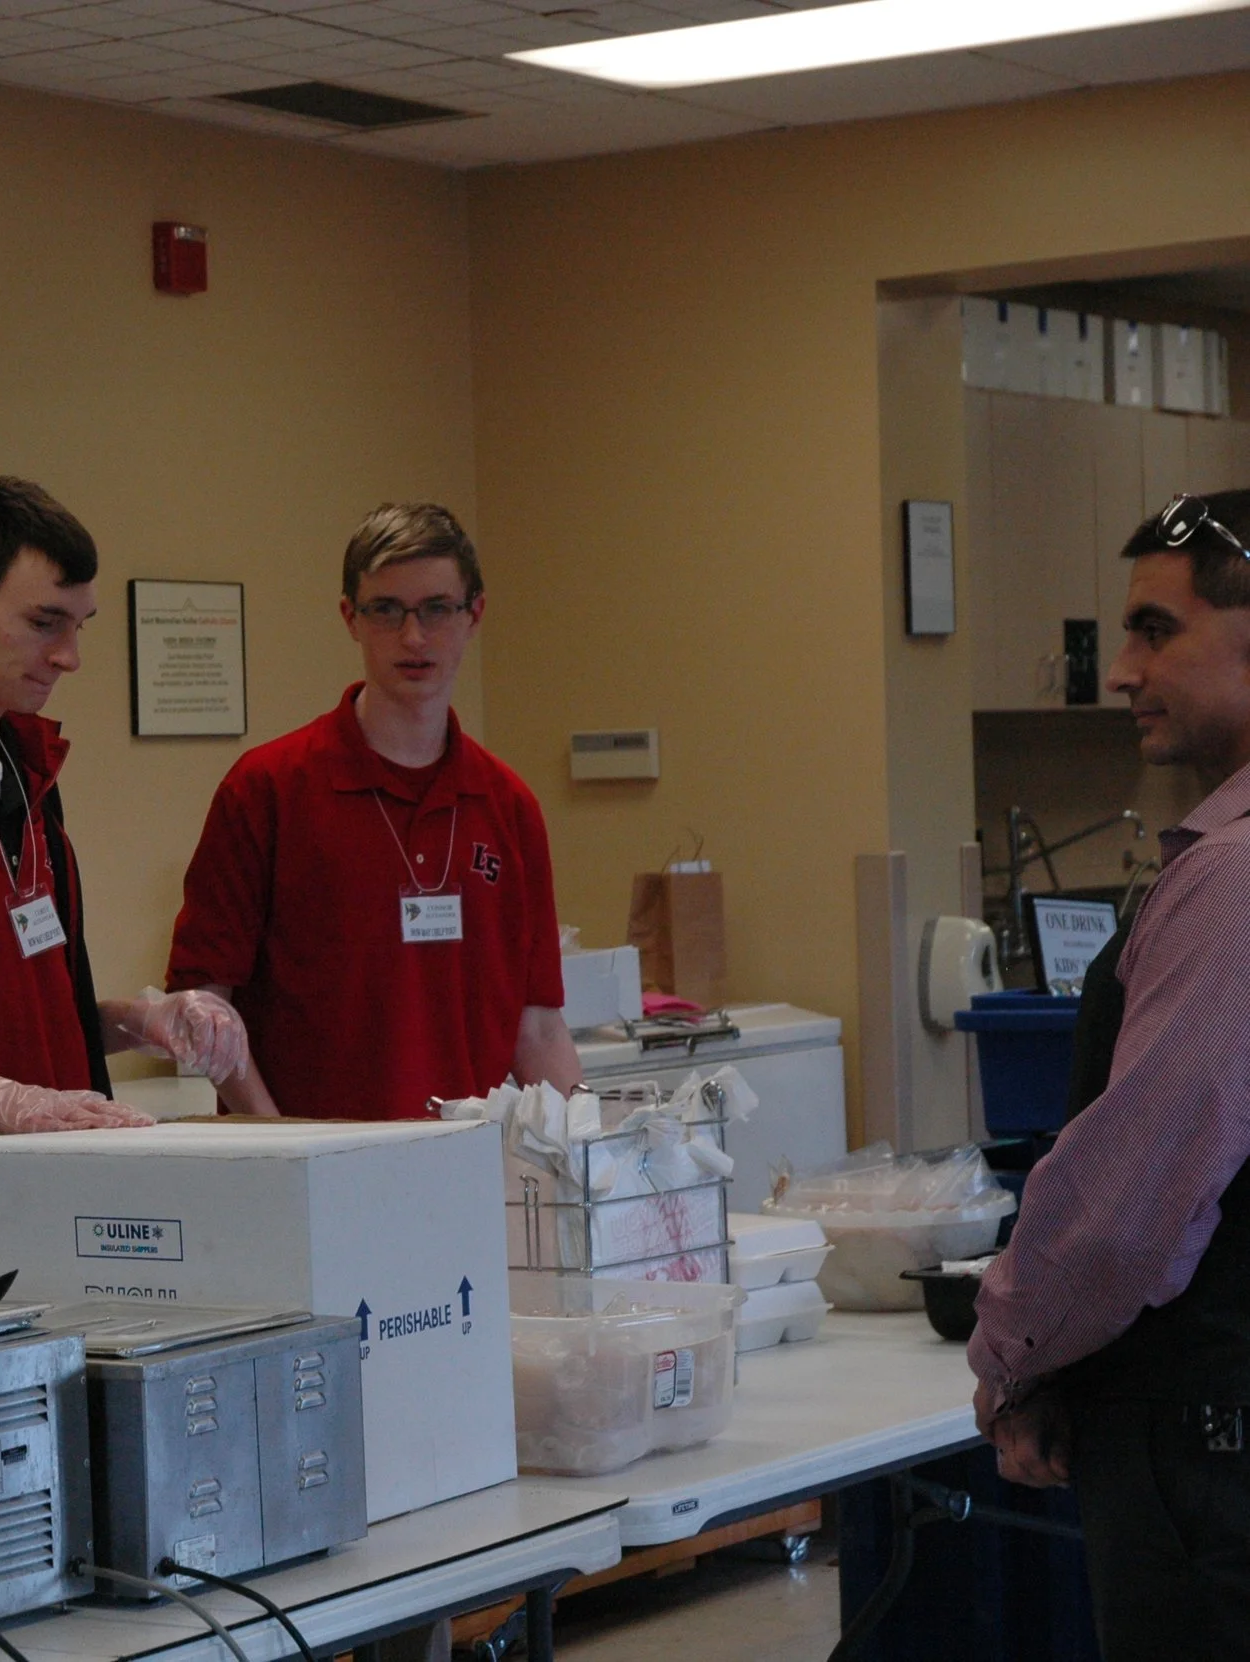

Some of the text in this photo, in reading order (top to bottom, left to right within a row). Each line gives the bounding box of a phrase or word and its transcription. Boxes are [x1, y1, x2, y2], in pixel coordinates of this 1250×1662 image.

[471, 841, 502, 886] LS
[1045, 911, 1108, 933] ONE DRINK
[107, 1223, 150, 1240] ULINE
[100, 1244, 158, 1254] INSULATED SHIPPERS
[379, 1304, 451, 1340] PERISHABLE
[461, 1321, 473, 1335] UP
[359, 1346, 370, 1360] UP
